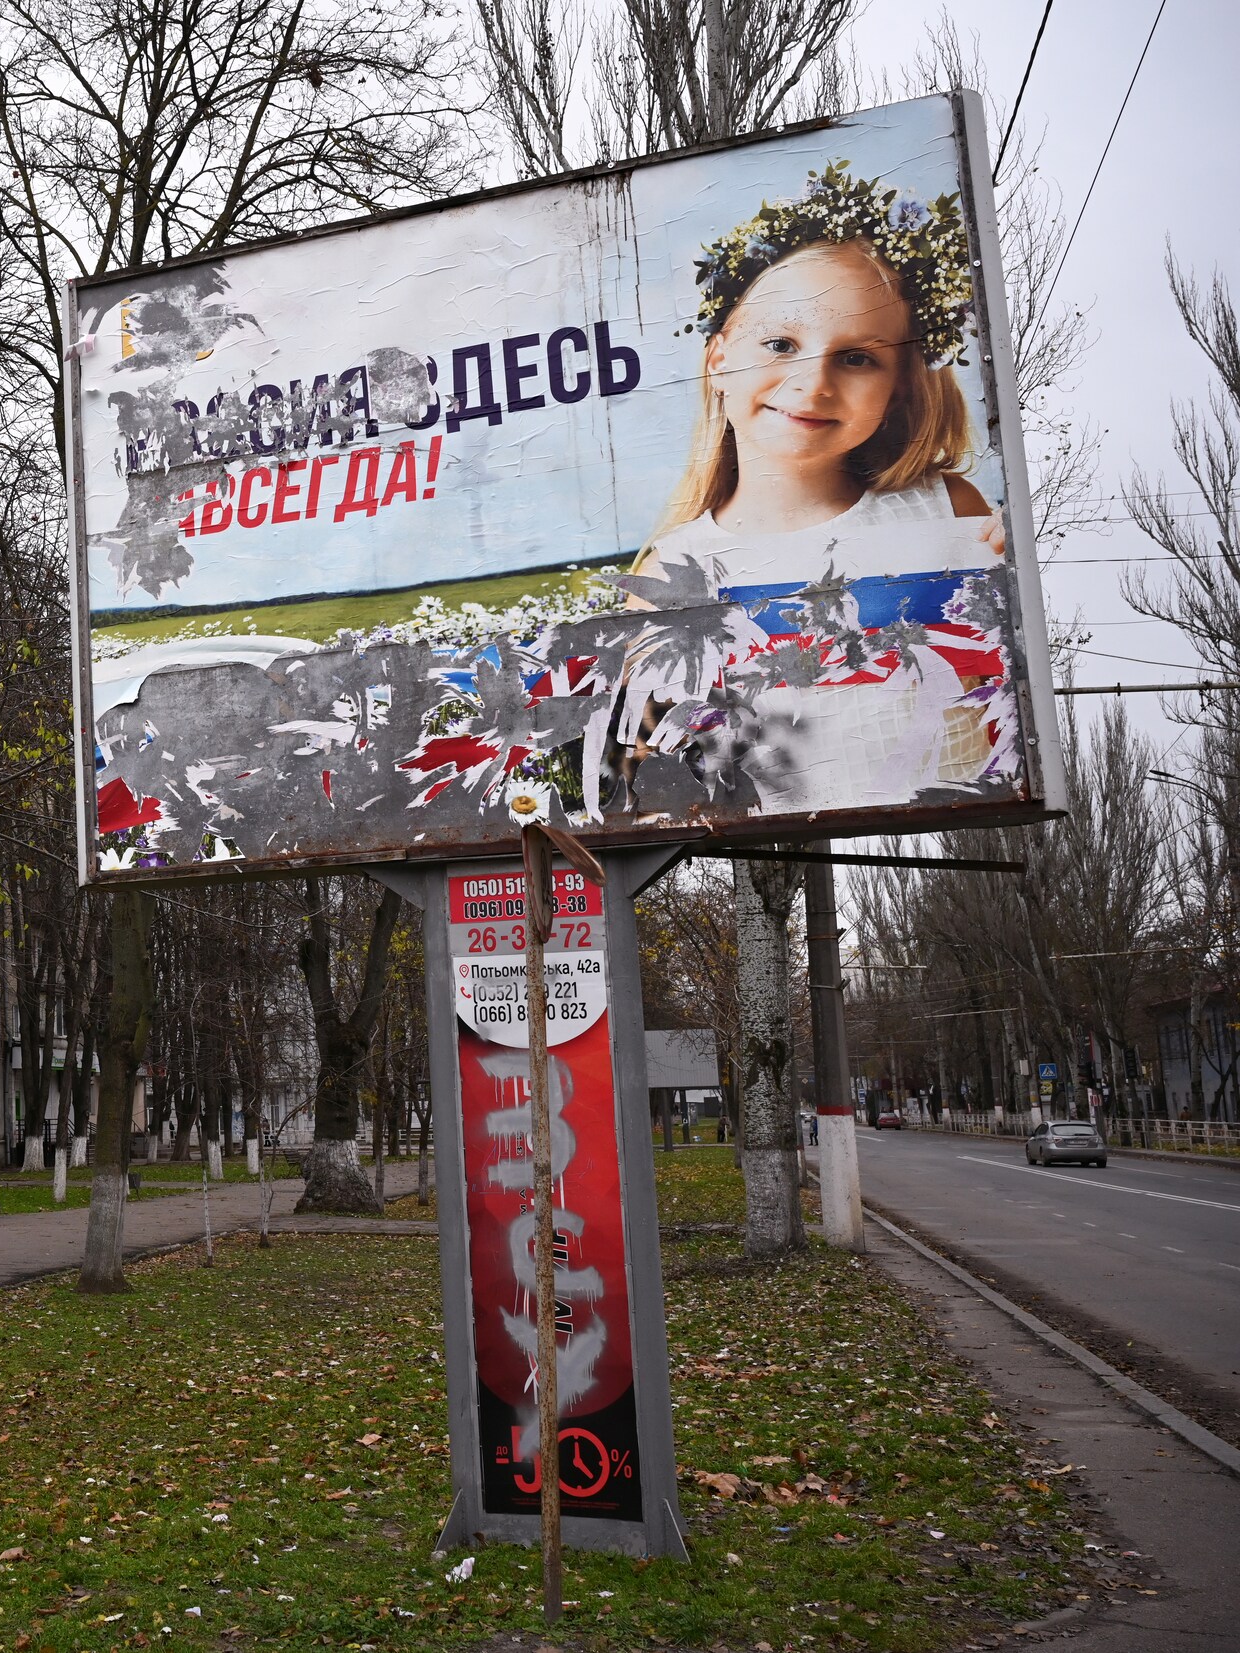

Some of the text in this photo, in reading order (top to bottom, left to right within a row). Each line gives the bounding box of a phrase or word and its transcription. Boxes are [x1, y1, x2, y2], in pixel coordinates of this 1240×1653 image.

[463, 879, 503, 898] (050)
[464, 900, 503, 919] (096)
[467, 922, 592, 953] 26-3-72
[555, 982, 578, 999] 221
[474, 1004, 512, 1025] (066)
[561, 1002, 588, 1020] 823
